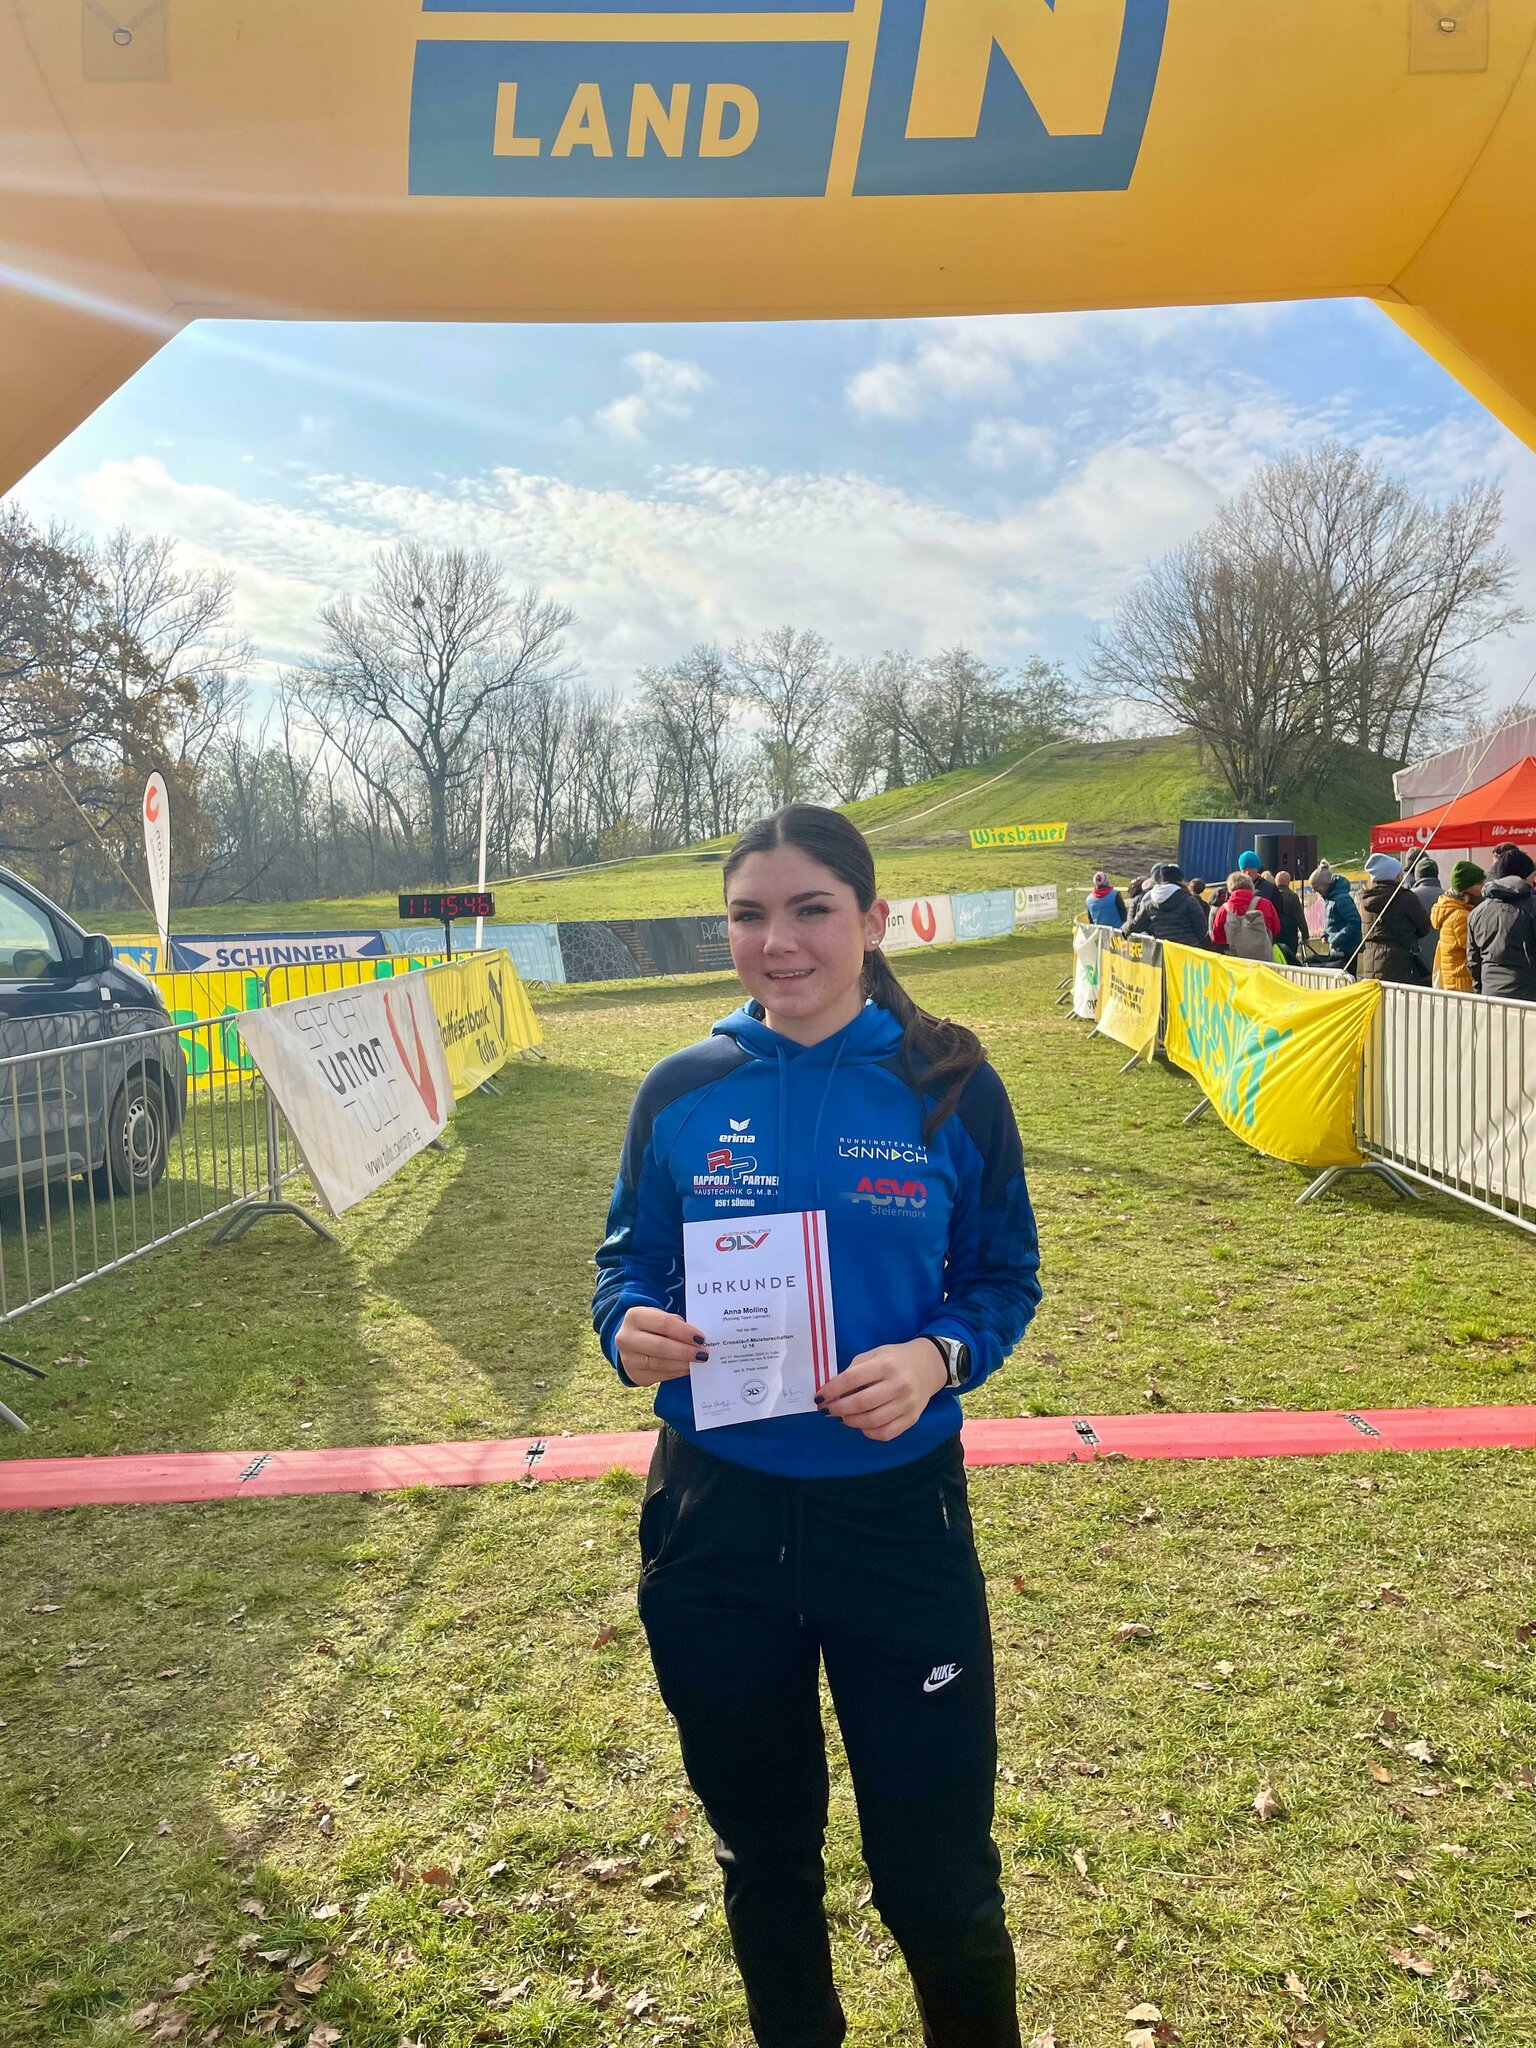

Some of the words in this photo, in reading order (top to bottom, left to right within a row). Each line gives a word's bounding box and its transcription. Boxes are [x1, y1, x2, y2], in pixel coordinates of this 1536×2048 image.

[492, 82, 760, 159] LAND
[971, 825, 1065, 846] Wiesbauer
[1378, 835, 1415, 844] union
[408, 894, 491, 917] 11:15:46
[215, 943, 351, 968] SCHINNERL
[293, 994, 371, 1051] SPORT
[475, 1031, 499, 1066] Tulln
[317, 1036, 392, 1096] union
[719, 1133, 756, 1143] erima
[839, 1136, 927, 1152] RUNNINGTEAM.AT
[693, 1175, 730, 1186] RAPPOLD
[714, 1198, 730, 1207] 8561
[871, 1205, 927, 1219] Steiermark
[697, 1275, 796, 1295] URKUNDE
[723, 1308, 742, 1316] Anna
[743, 1306, 768, 1315] Molling
[929, 1662, 957, 1681] NIKE
